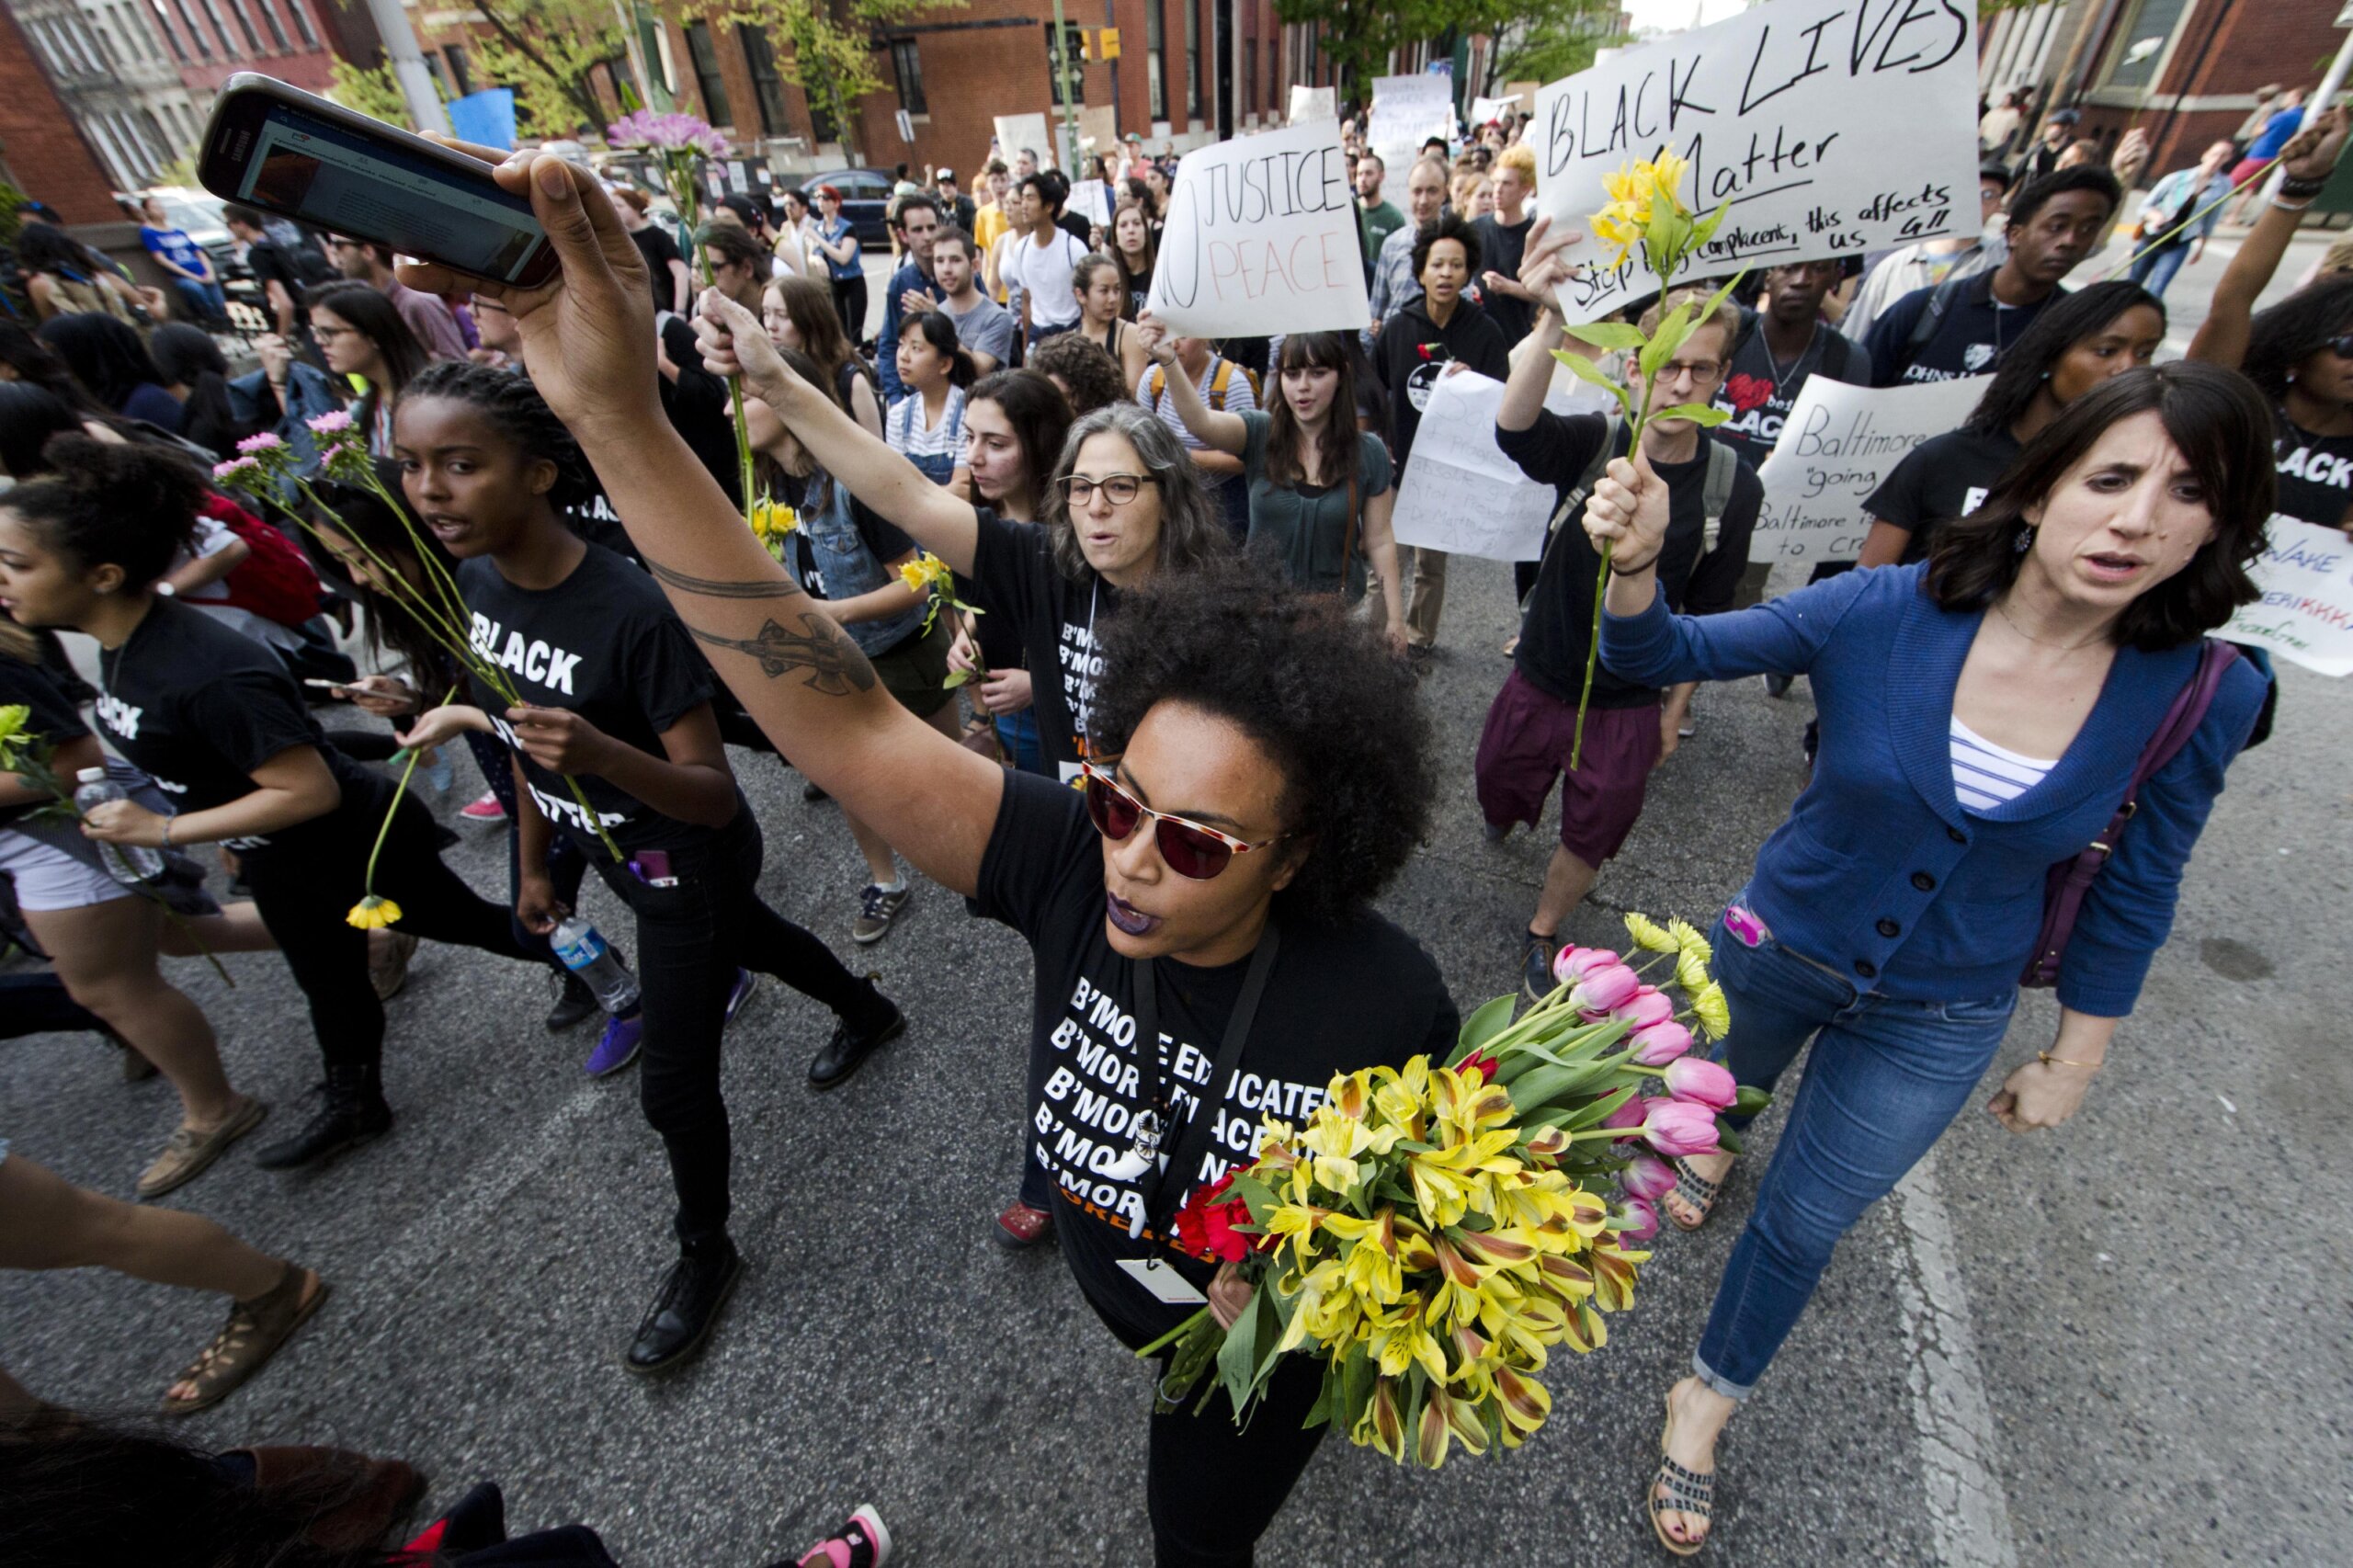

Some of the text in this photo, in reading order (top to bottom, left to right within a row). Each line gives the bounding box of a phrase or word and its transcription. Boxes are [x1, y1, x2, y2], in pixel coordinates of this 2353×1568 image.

[1548, 0, 1968, 178] BLACK LIVES
[231, 130, 251, 163] SAMSUNG
[1204, 146, 1347, 227] JUSTICE
[1208, 231, 1350, 301] PEACE
[1571, 252, 1634, 307] Stop
[1805, 205, 1841, 233] this
[1858, 183, 1950, 222] affects
[1829, 230, 1867, 249] us
[1795, 403, 1927, 458] Baltimore
[2272, 438, 2353, 489] LACK
[1753, 501, 1847, 531] Baltimore
[1779, 536, 1805, 556] to
[2263, 531, 2343, 574] WAKE
[469, 611, 583, 696] BLACK
[1070, 976, 1174, 1066] B'MOE
[1051, 1017, 1166, 1099] B'MOR
[1044, 1065, 1142, 1140] B'MO
[1036, 1142, 1145, 1220] B'MOR
